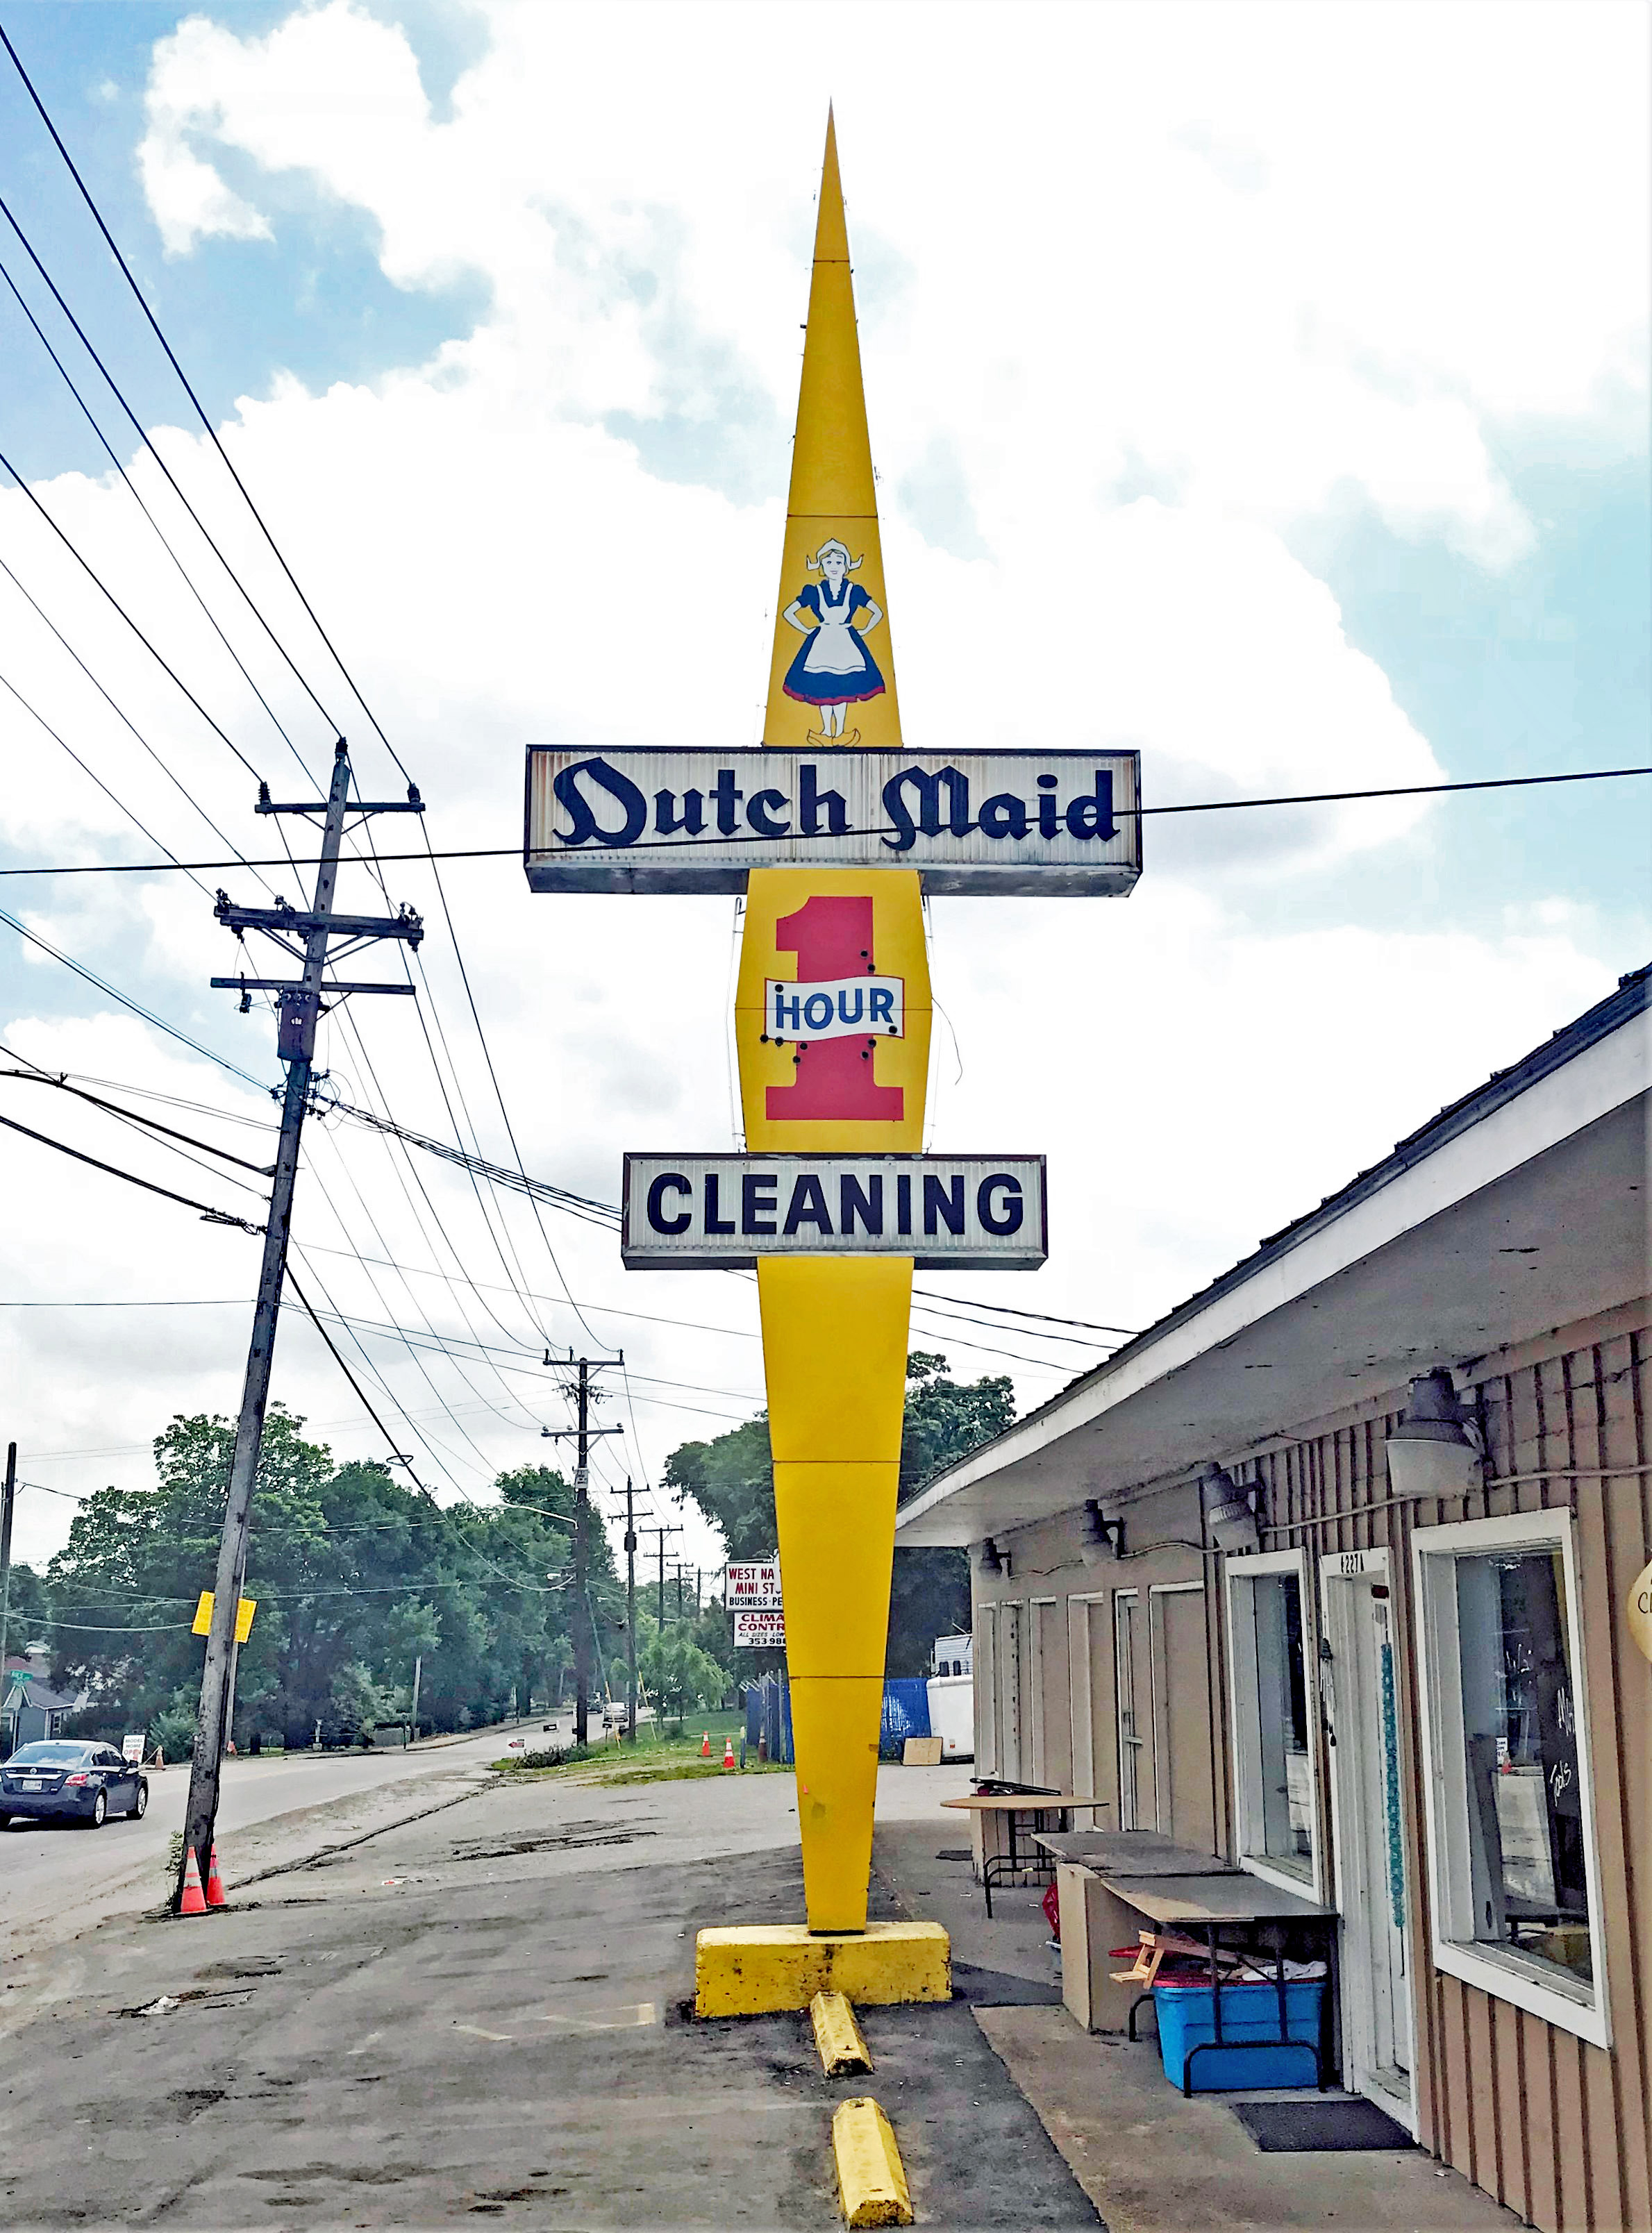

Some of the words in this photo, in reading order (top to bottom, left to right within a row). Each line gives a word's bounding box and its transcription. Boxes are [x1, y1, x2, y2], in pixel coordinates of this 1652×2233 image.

[553, 757, 853, 845] Dutch
[880, 765, 1121, 851] Maid
[765, 896, 904, 1121] 1
[776, 987, 894, 1030] HOUR
[646, 1172, 1024, 1236] CLEANING
[728, 1568, 757, 1580] WEST
[761, 1568, 775, 1580] NA
[735, 1582, 758, 1594] MINI
[762, 1582, 781, 1594] ST
[729, 1597, 768, 1606] BUSINESS
[772, 1597, 783, 1606] PE
[741, 1614, 785, 1622] CLIMA
[738, 1623, 785, 1631] CONTR
